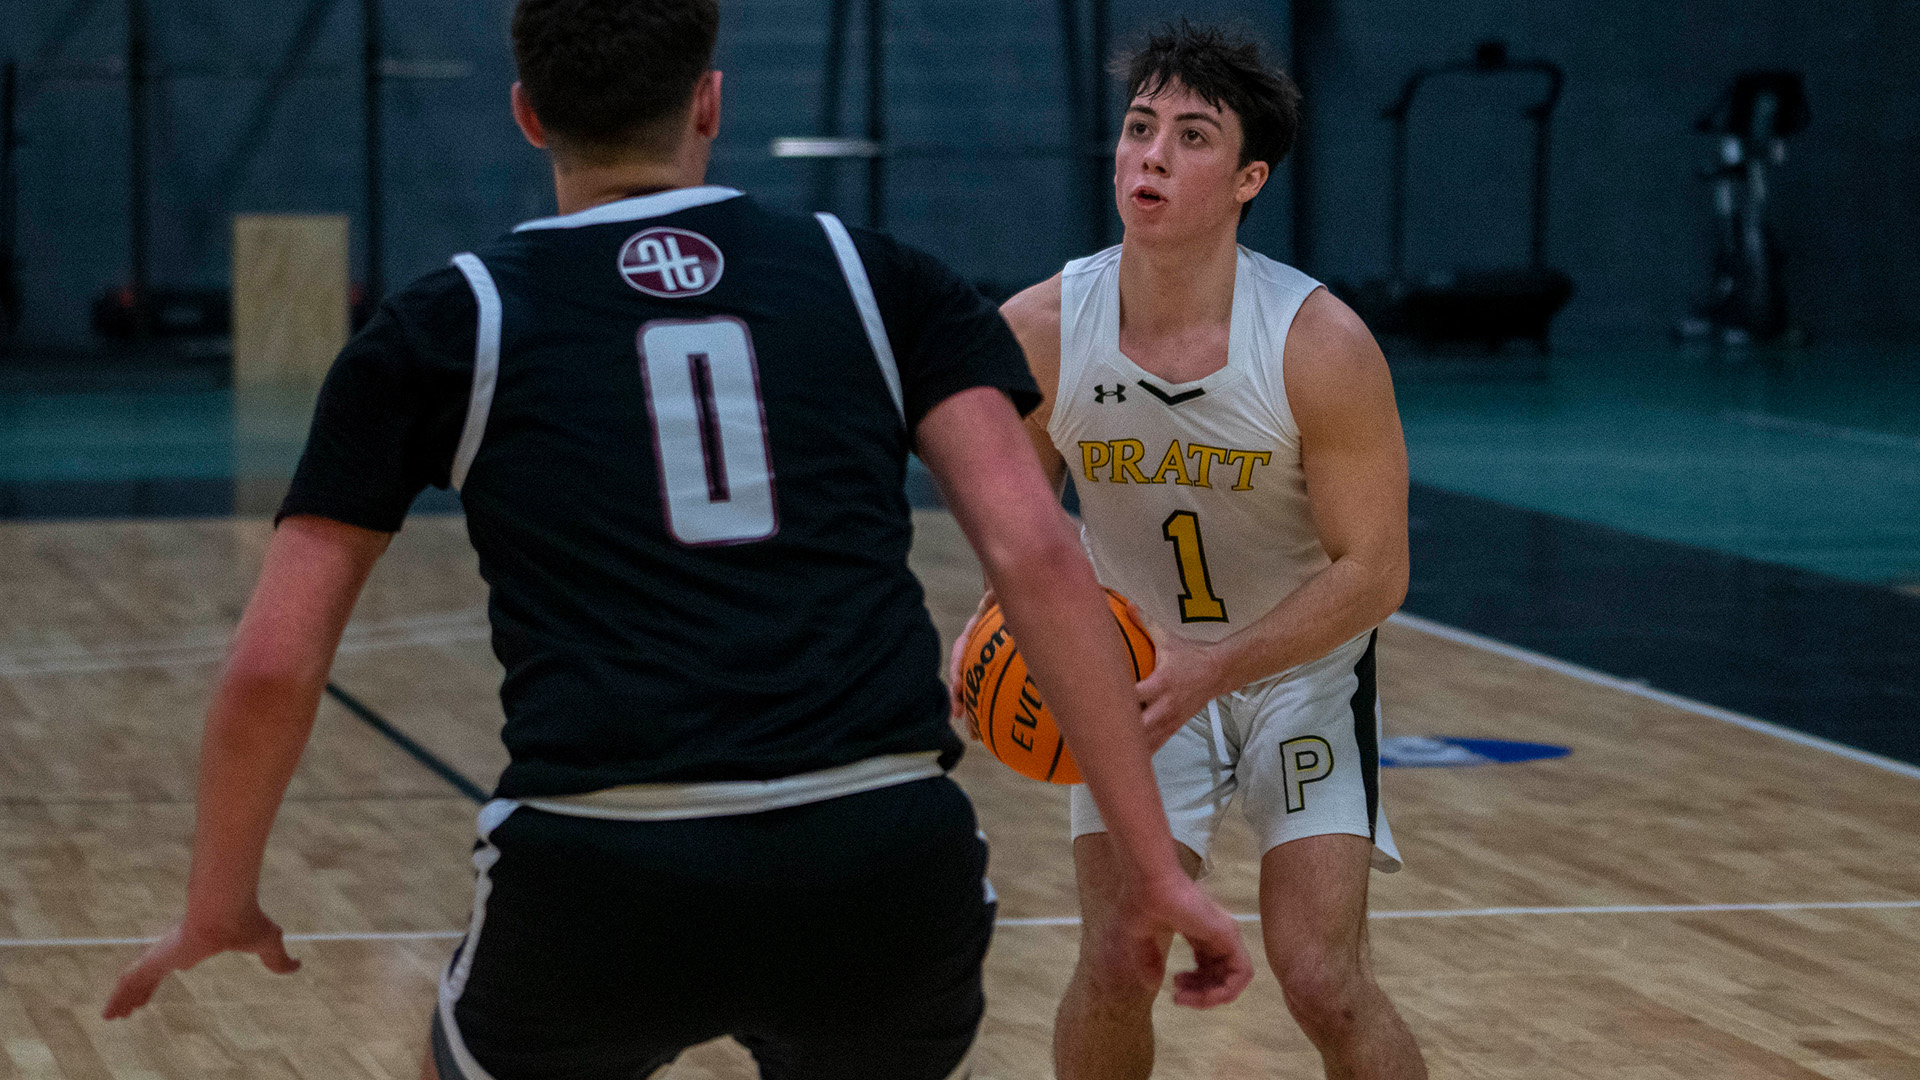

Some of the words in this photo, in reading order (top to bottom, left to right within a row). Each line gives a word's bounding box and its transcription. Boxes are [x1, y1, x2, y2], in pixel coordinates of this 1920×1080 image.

[636, 315, 779, 545] 0
[1078, 438, 1272, 491] PRATT
[1162, 510, 1229, 623] 1
[1279, 735, 1334, 814] P
